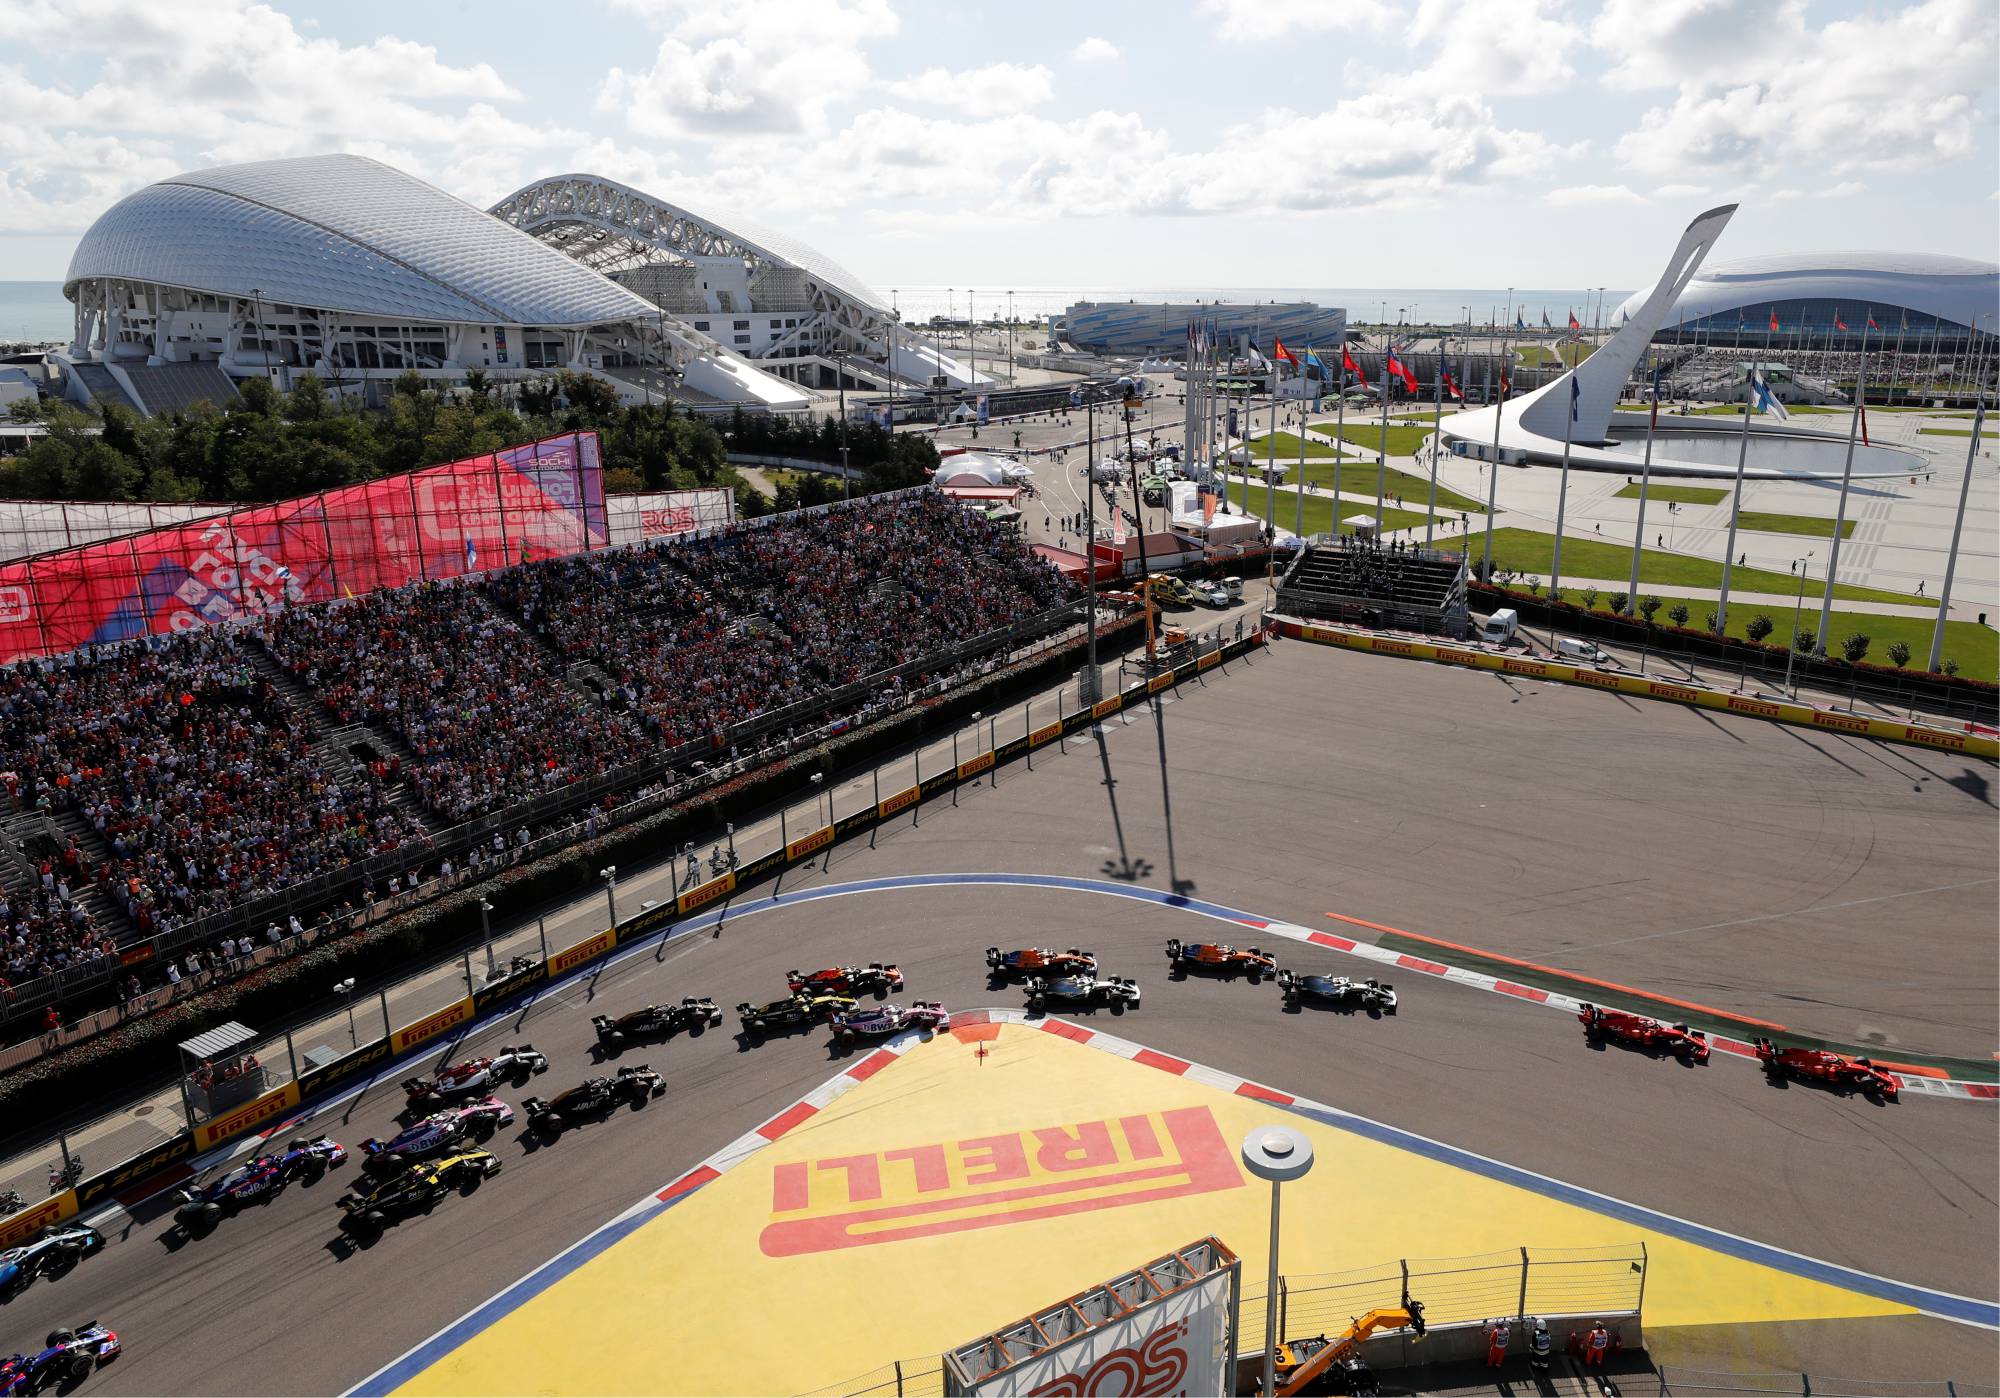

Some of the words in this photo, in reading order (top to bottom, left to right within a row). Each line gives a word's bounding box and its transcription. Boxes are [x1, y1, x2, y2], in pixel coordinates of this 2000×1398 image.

[529, 458, 570, 466] SOCHI
[1436, 649, 1477, 664] PIRELLI
[1503, 659, 1547, 676] PIRELLI
[1574, 670, 1620, 688] PIRELLI
[1650, 683, 1698, 701] PIRELLI
[1728, 697, 1780, 716] PIRELLI
[1813, 712, 1870, 732] PIRELLI
[1033, 725, 1058, 744] PIRELLI
[1905, 727, 1965, 749] PIRELLI
[962, 755, 991, 776] PIRELLI
[883, 790, 915, 813] PIRELLI
[847, 810, 877, 828] ZERO
[792, 830, 829, 857] PIRELLI
[749, 854, 785, 876] ZERO
[684, 878, 728, 909] PIRELLI
[633, 905, 676, 930] ZERO
[555, 935, 608, 970] PIRELLI
[496, 968, 545, 998] ZERO
[401, 1005, 464, 1048] PIRELLI
[326, 1044, 387, 1082] ZERO
[207, 1091, 286, 1142] PIRELLI
[110, 1141, 190, 1189] ZERO
[759, 1105, 1247, 1258] PIRELLI
[0, 1201, 61, 1248] ELLI
